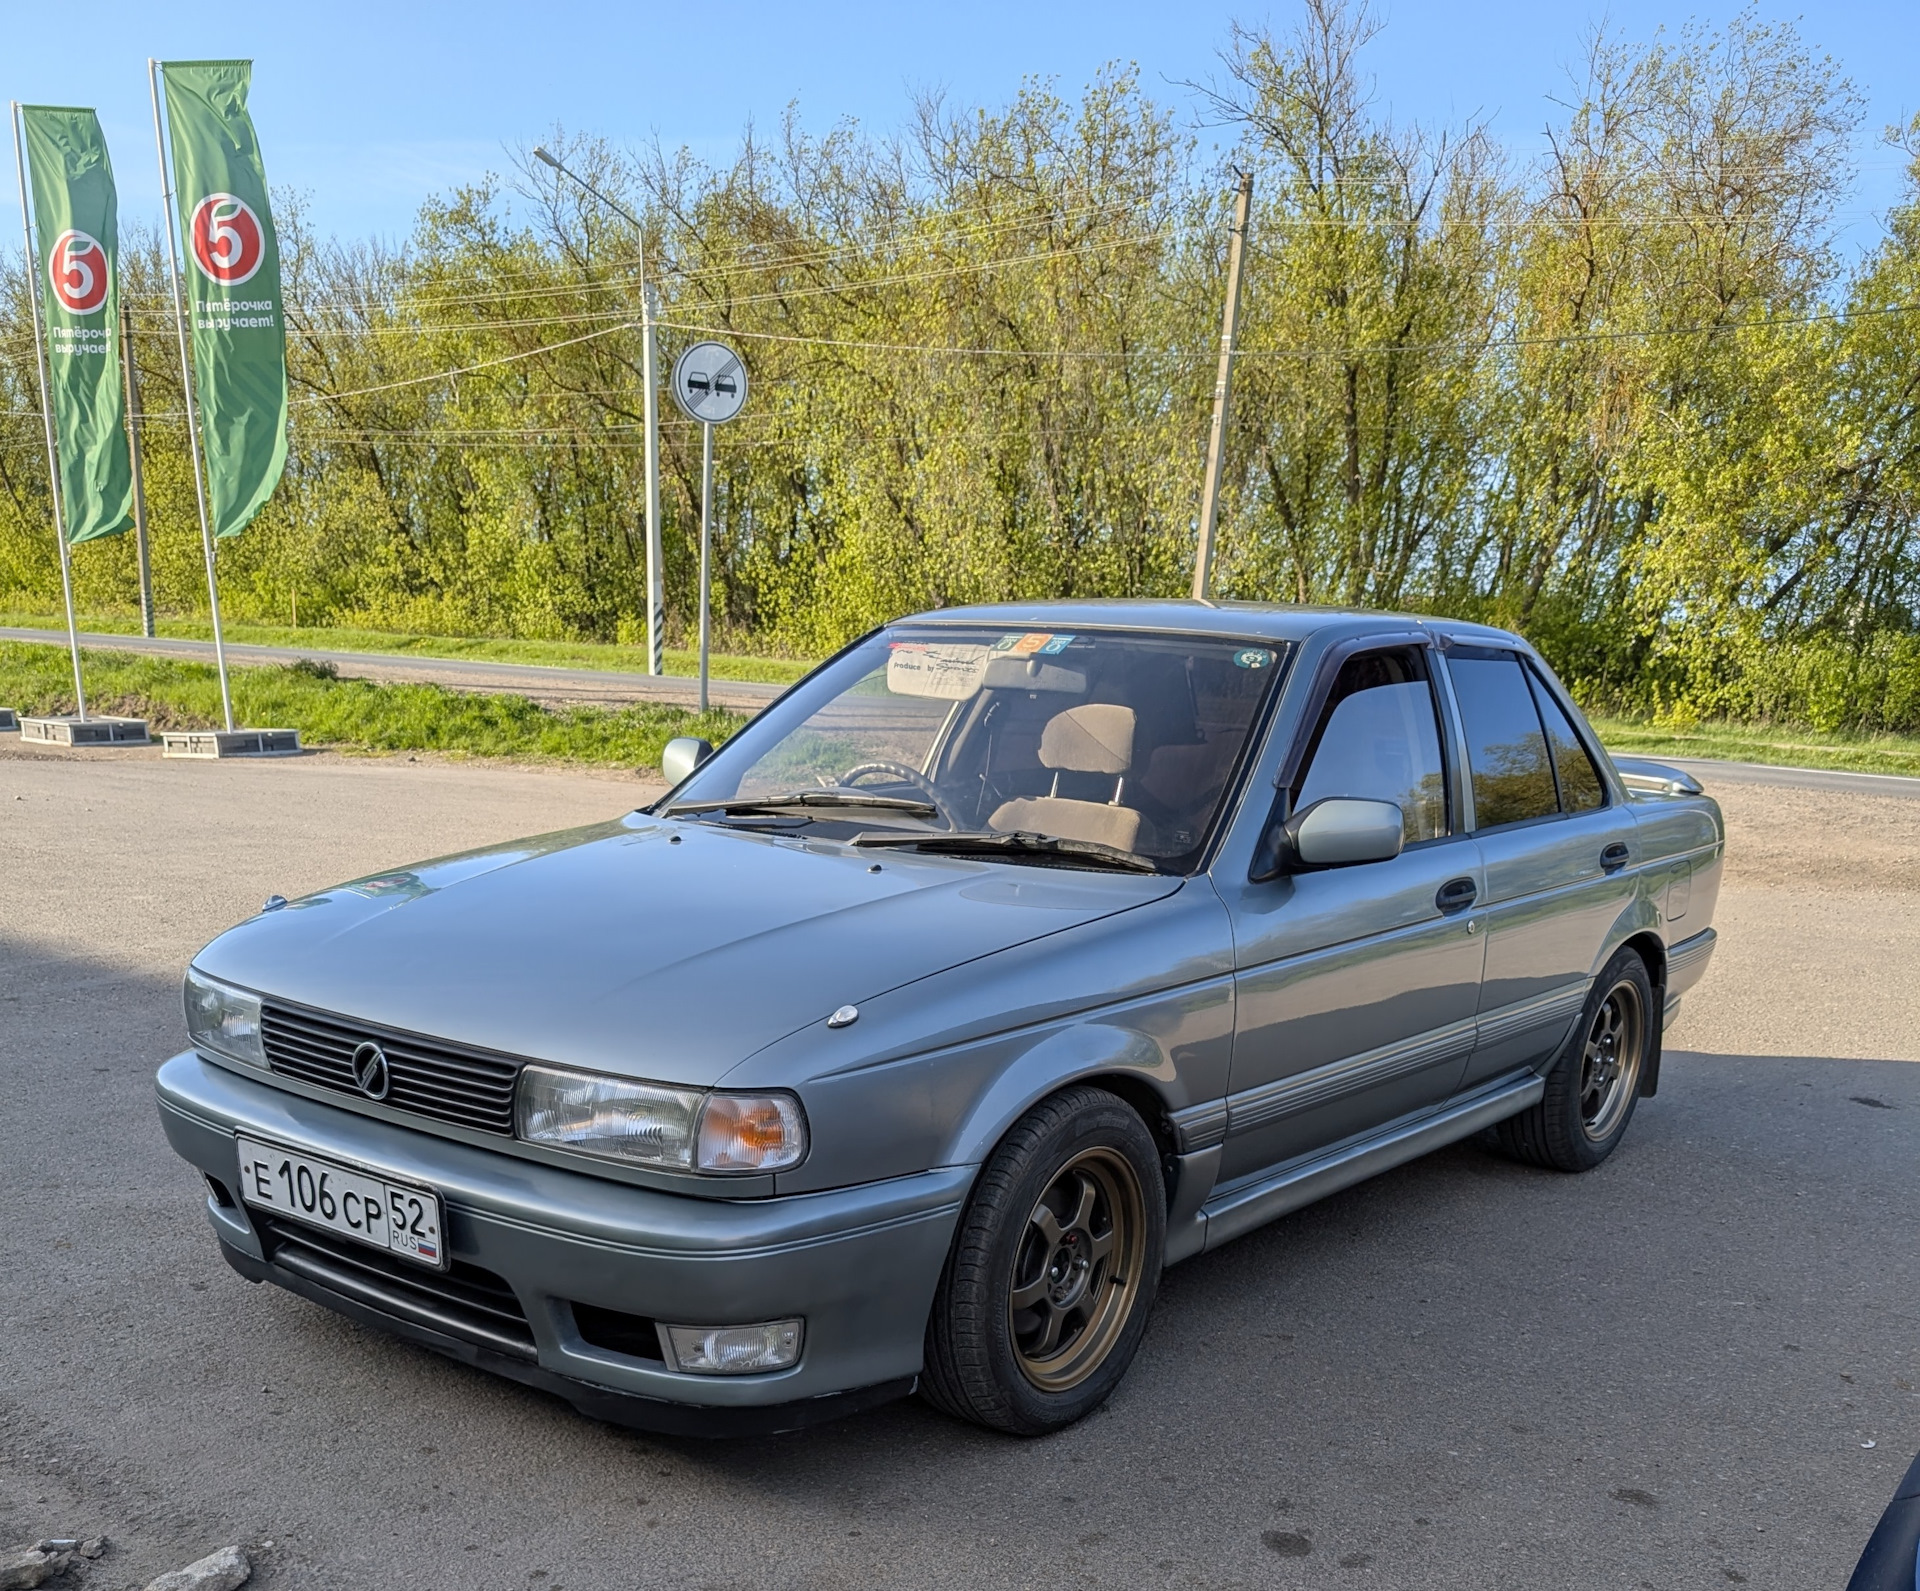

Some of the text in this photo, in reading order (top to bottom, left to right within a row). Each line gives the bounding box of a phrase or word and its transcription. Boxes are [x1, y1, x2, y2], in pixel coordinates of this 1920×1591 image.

[209, 200, 244, 268] 5
[62, 235, 97, 299] 5
[196, 298, 272, 314] Пятёрочка
[198, 315, 274, 331] выручает!
[389, 1190, 426, 1238] 52
[392, 1230, 417, 1250] RUS
